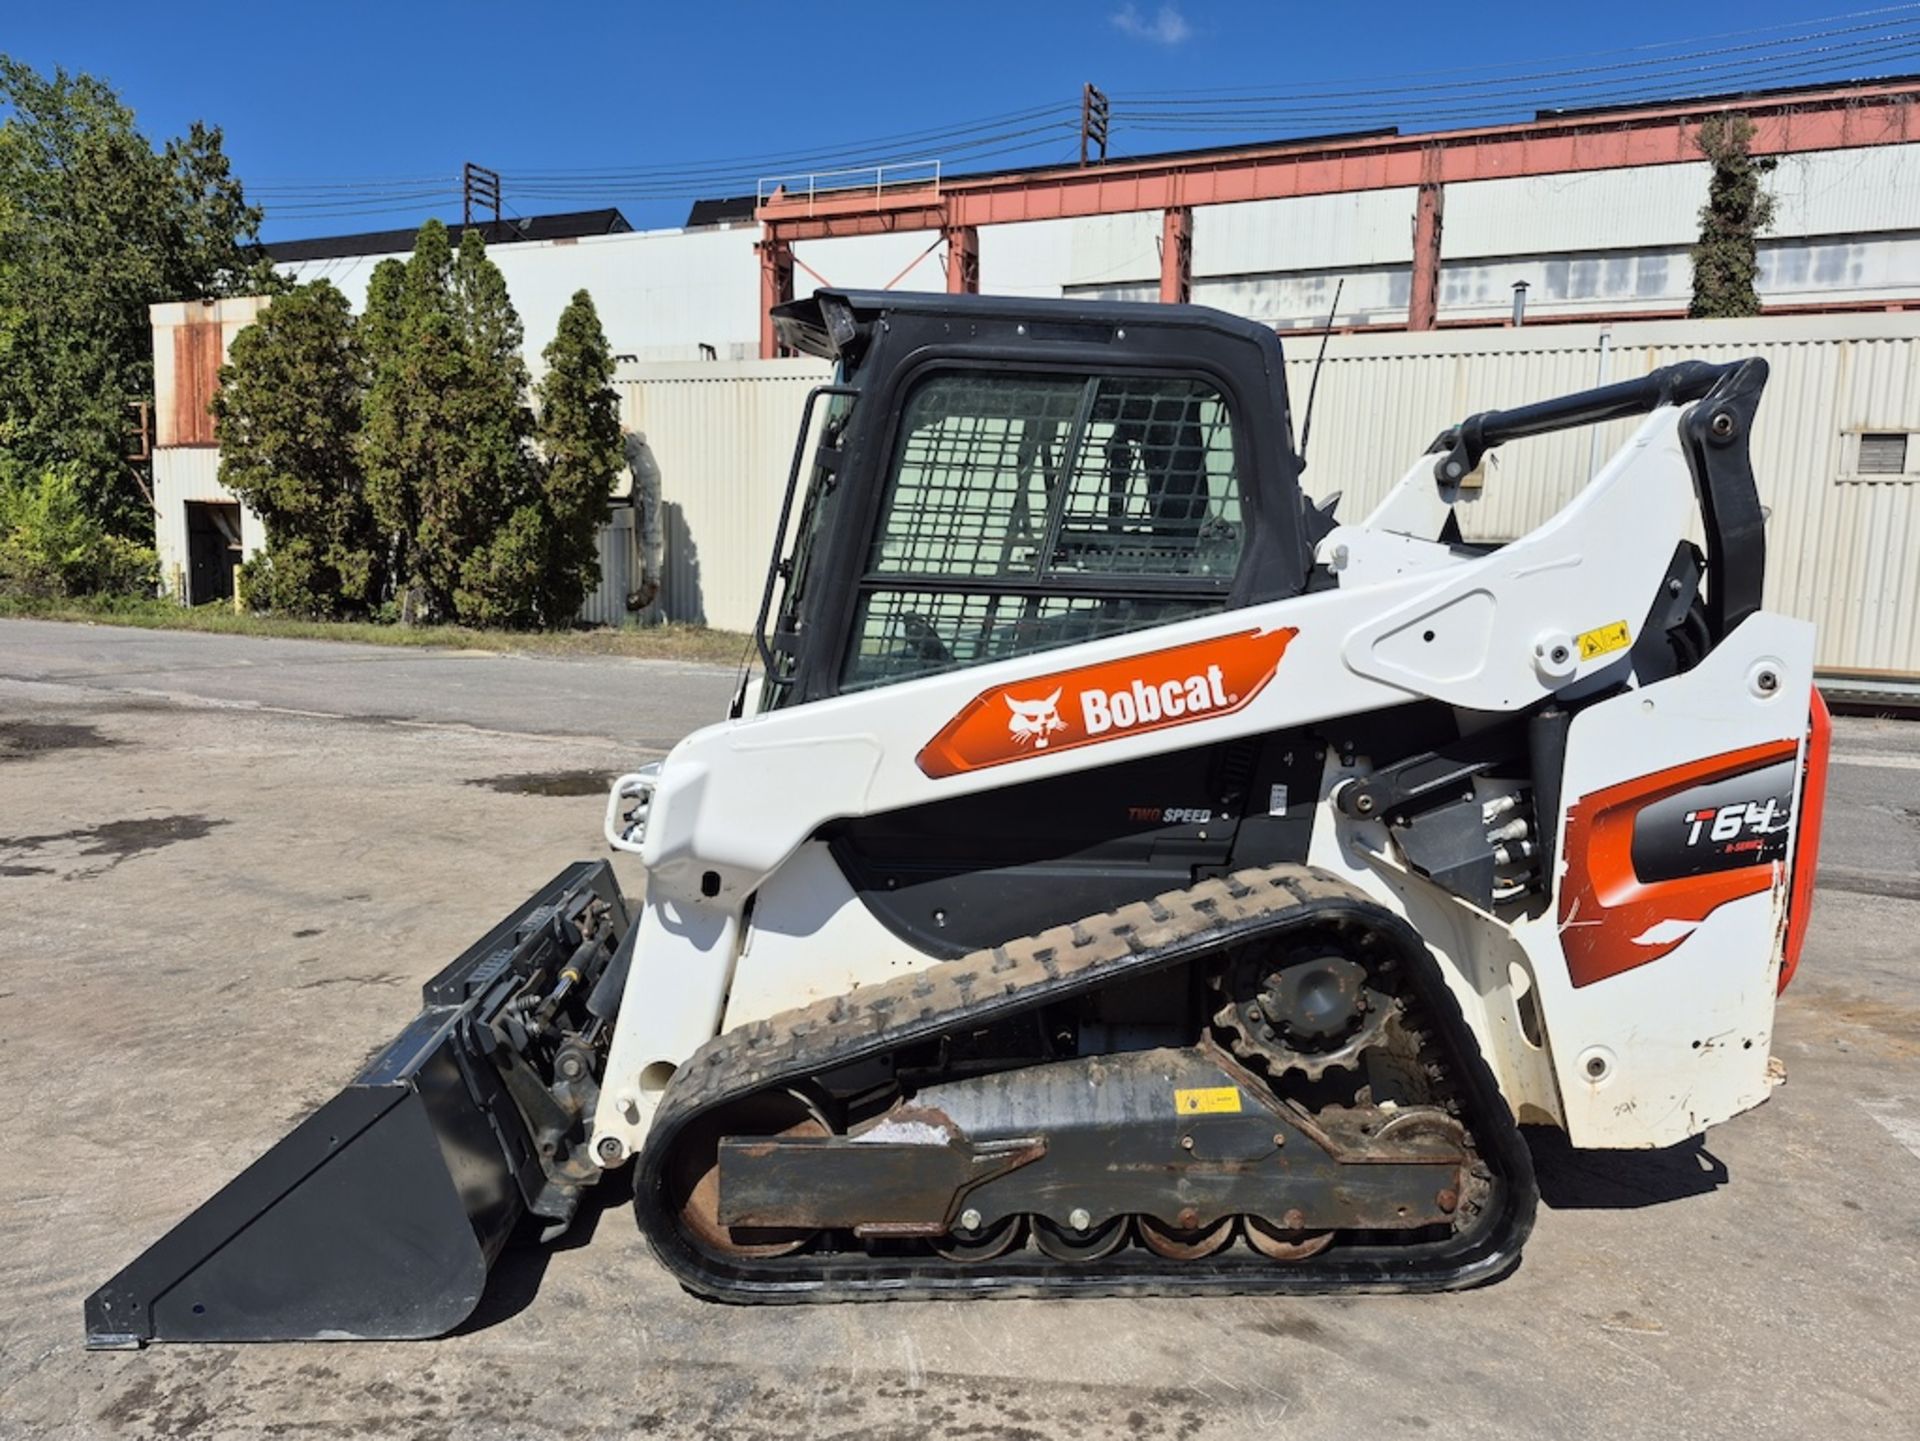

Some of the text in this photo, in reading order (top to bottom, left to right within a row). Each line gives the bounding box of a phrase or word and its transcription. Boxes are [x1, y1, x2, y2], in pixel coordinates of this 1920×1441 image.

[1080, 664, 1228, 734] Bobcat
[1127, 807, 1212, 823] TWO SPEED
[1685, 798, 1777, 846] T64
